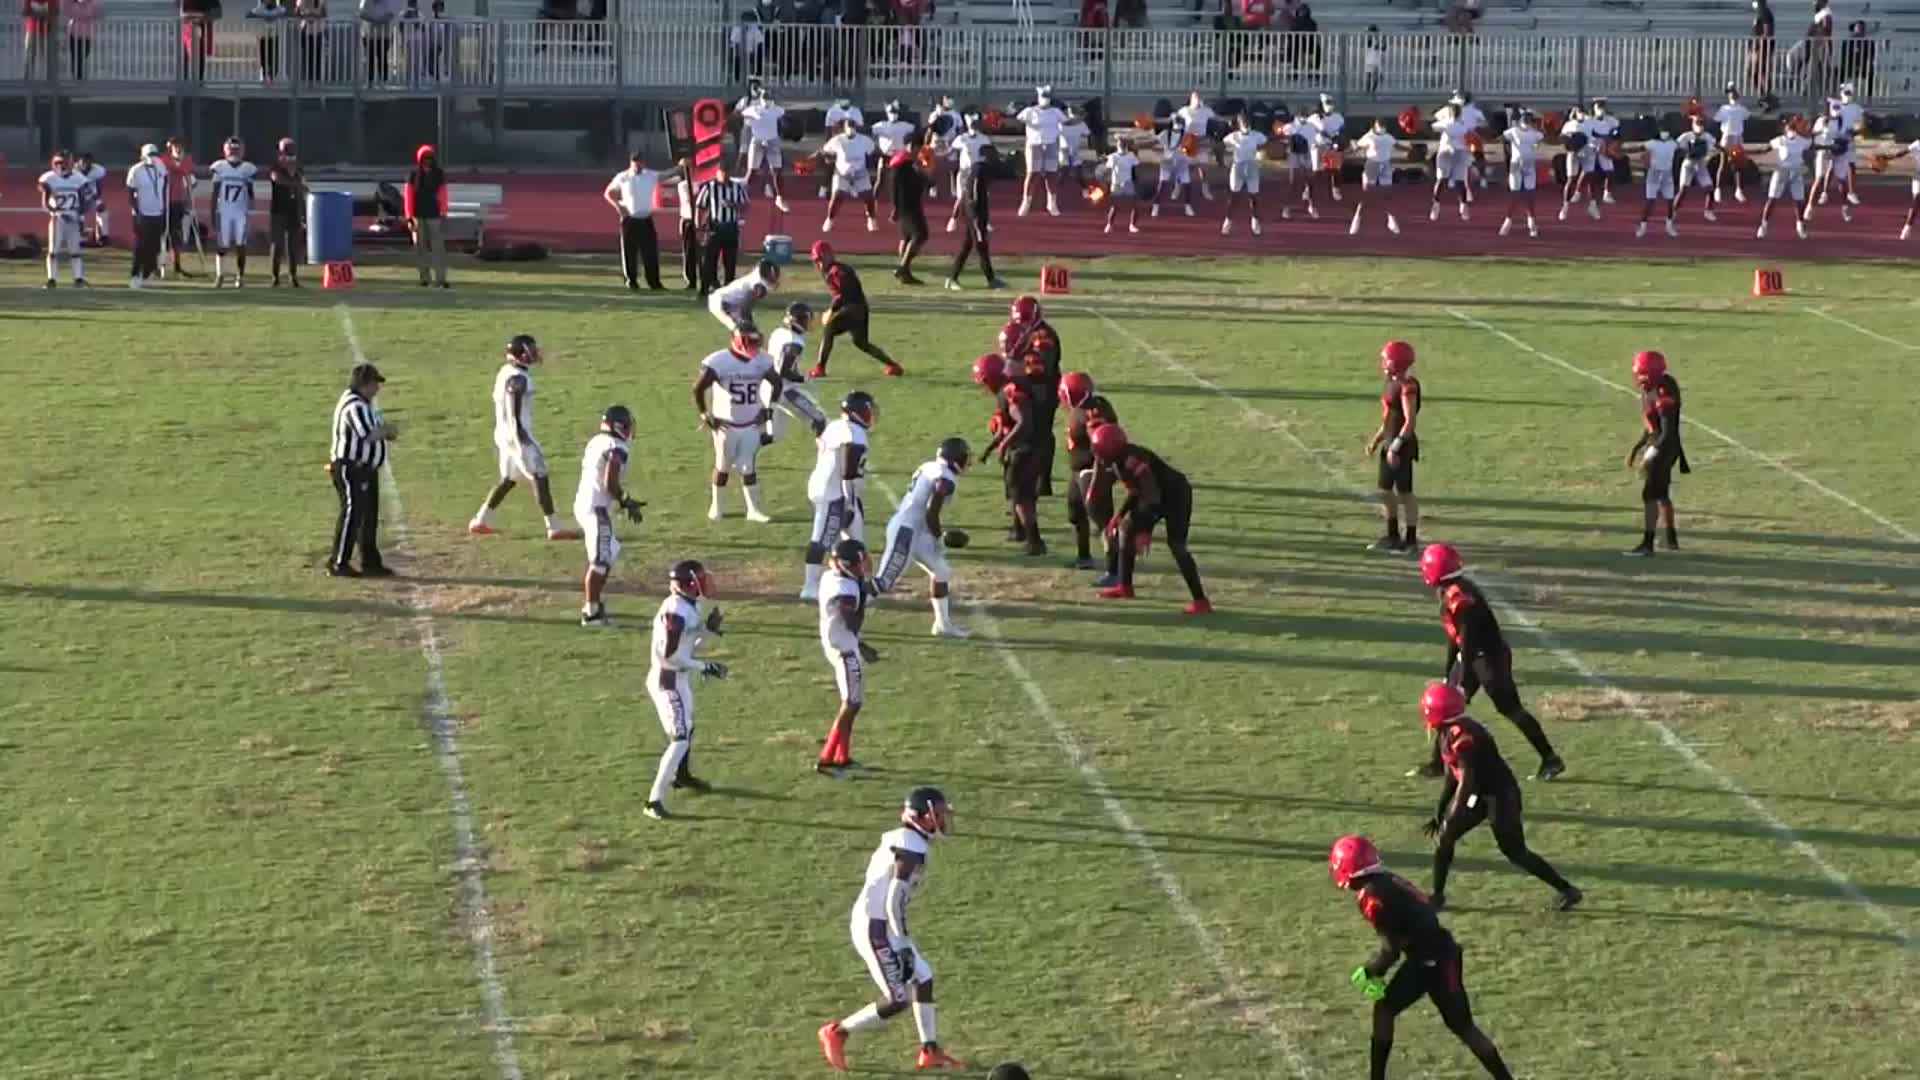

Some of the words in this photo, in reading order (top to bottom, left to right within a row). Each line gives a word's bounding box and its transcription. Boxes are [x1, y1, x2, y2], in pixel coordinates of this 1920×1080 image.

[224, 184, 242, 202] 17
[329, 262, 352, 283] 50
[1046, 268, 1068, 289] 40
[1759, 270, 1782, 290] 30
